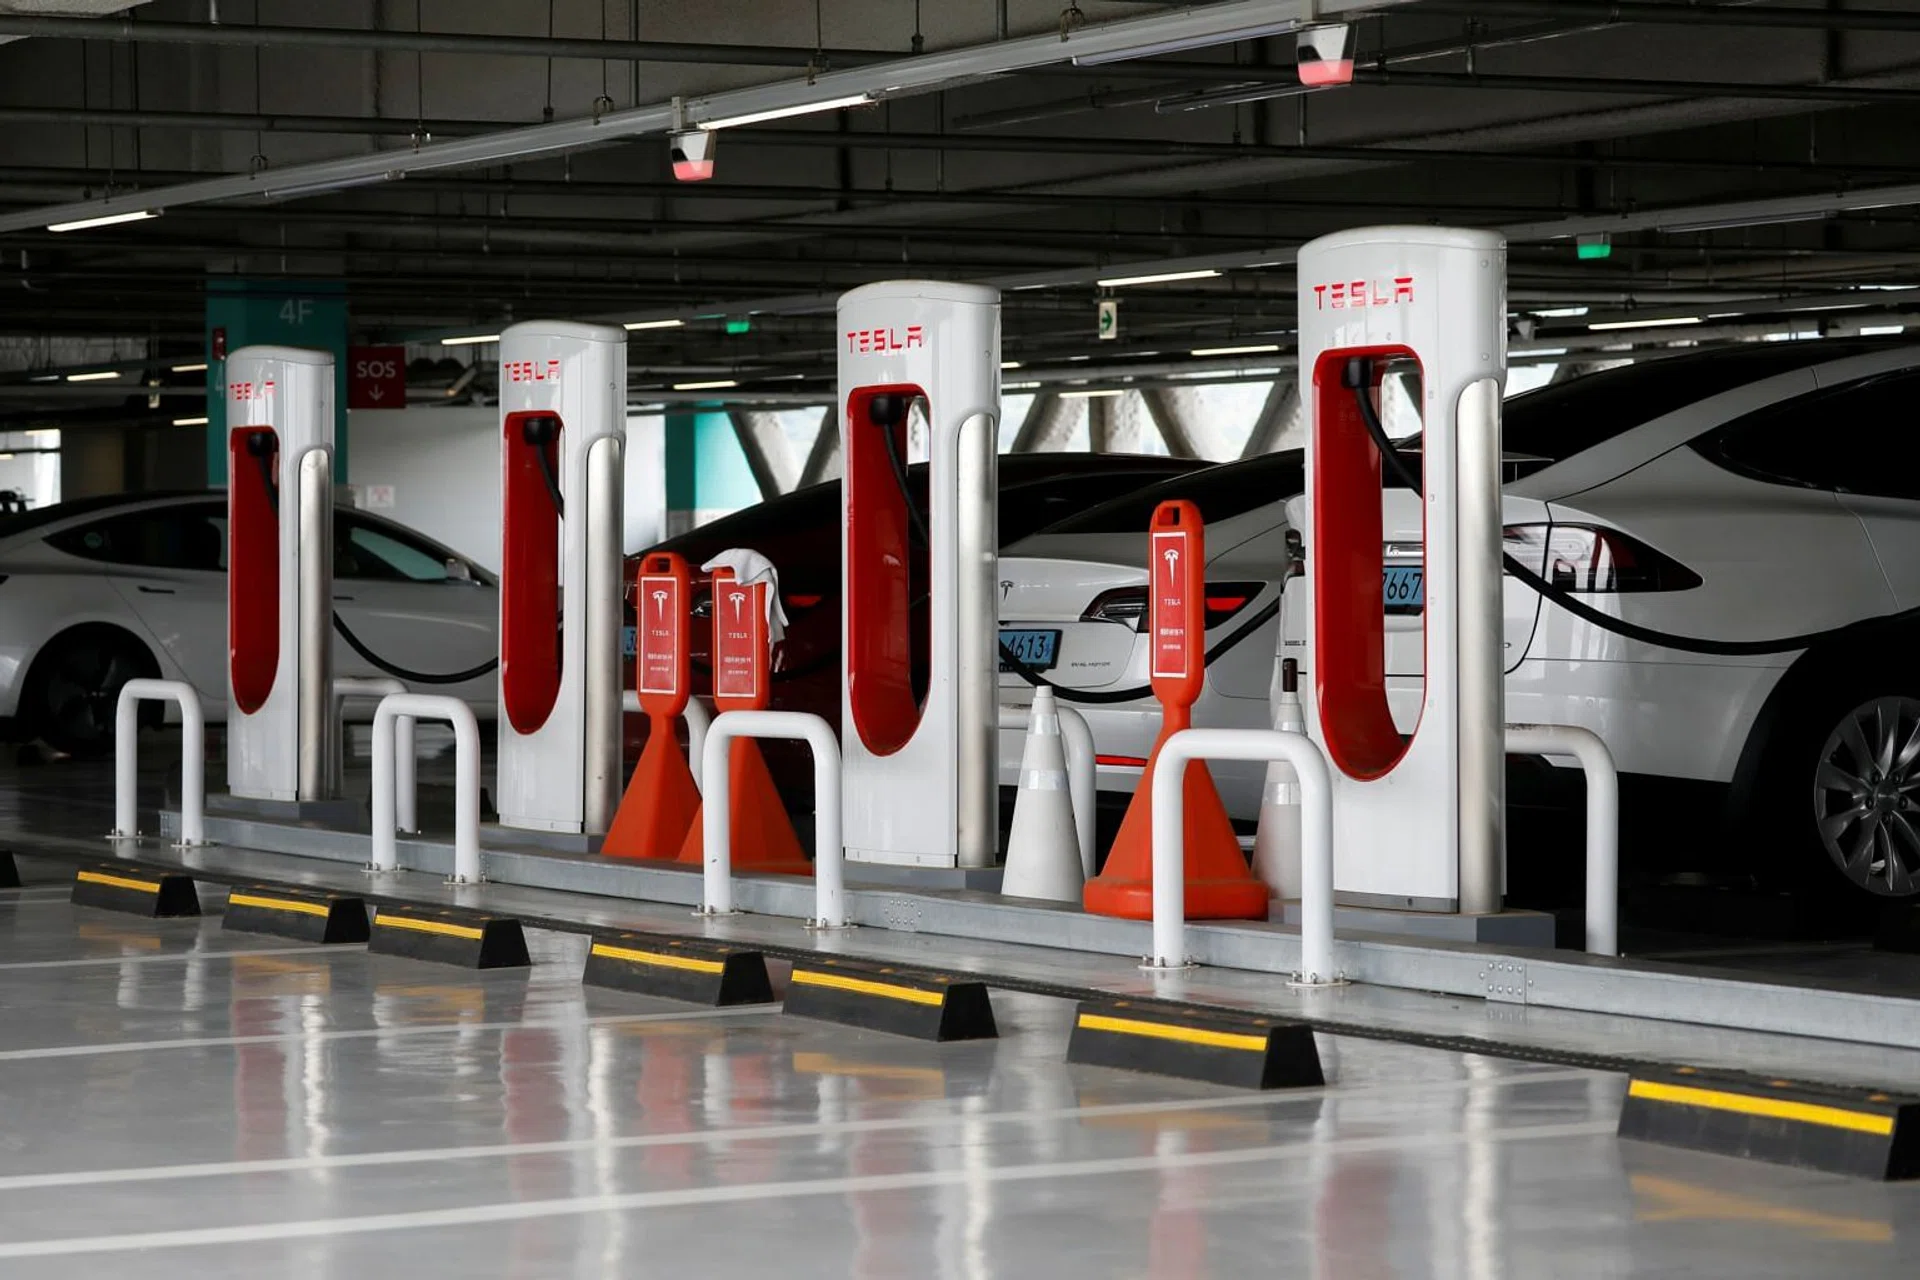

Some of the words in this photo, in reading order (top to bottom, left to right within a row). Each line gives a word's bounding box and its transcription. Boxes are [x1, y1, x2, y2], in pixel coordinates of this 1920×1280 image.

[1313, 277, 1414, 311] TESLA
[279, 299, 314, 324] 4F
[847, 326, 923, 354] TESLA
[356, 361, 397, 378] SOS
[504, 360, 560, 384] TESLA
[230, 381, 277, 400] TESA
